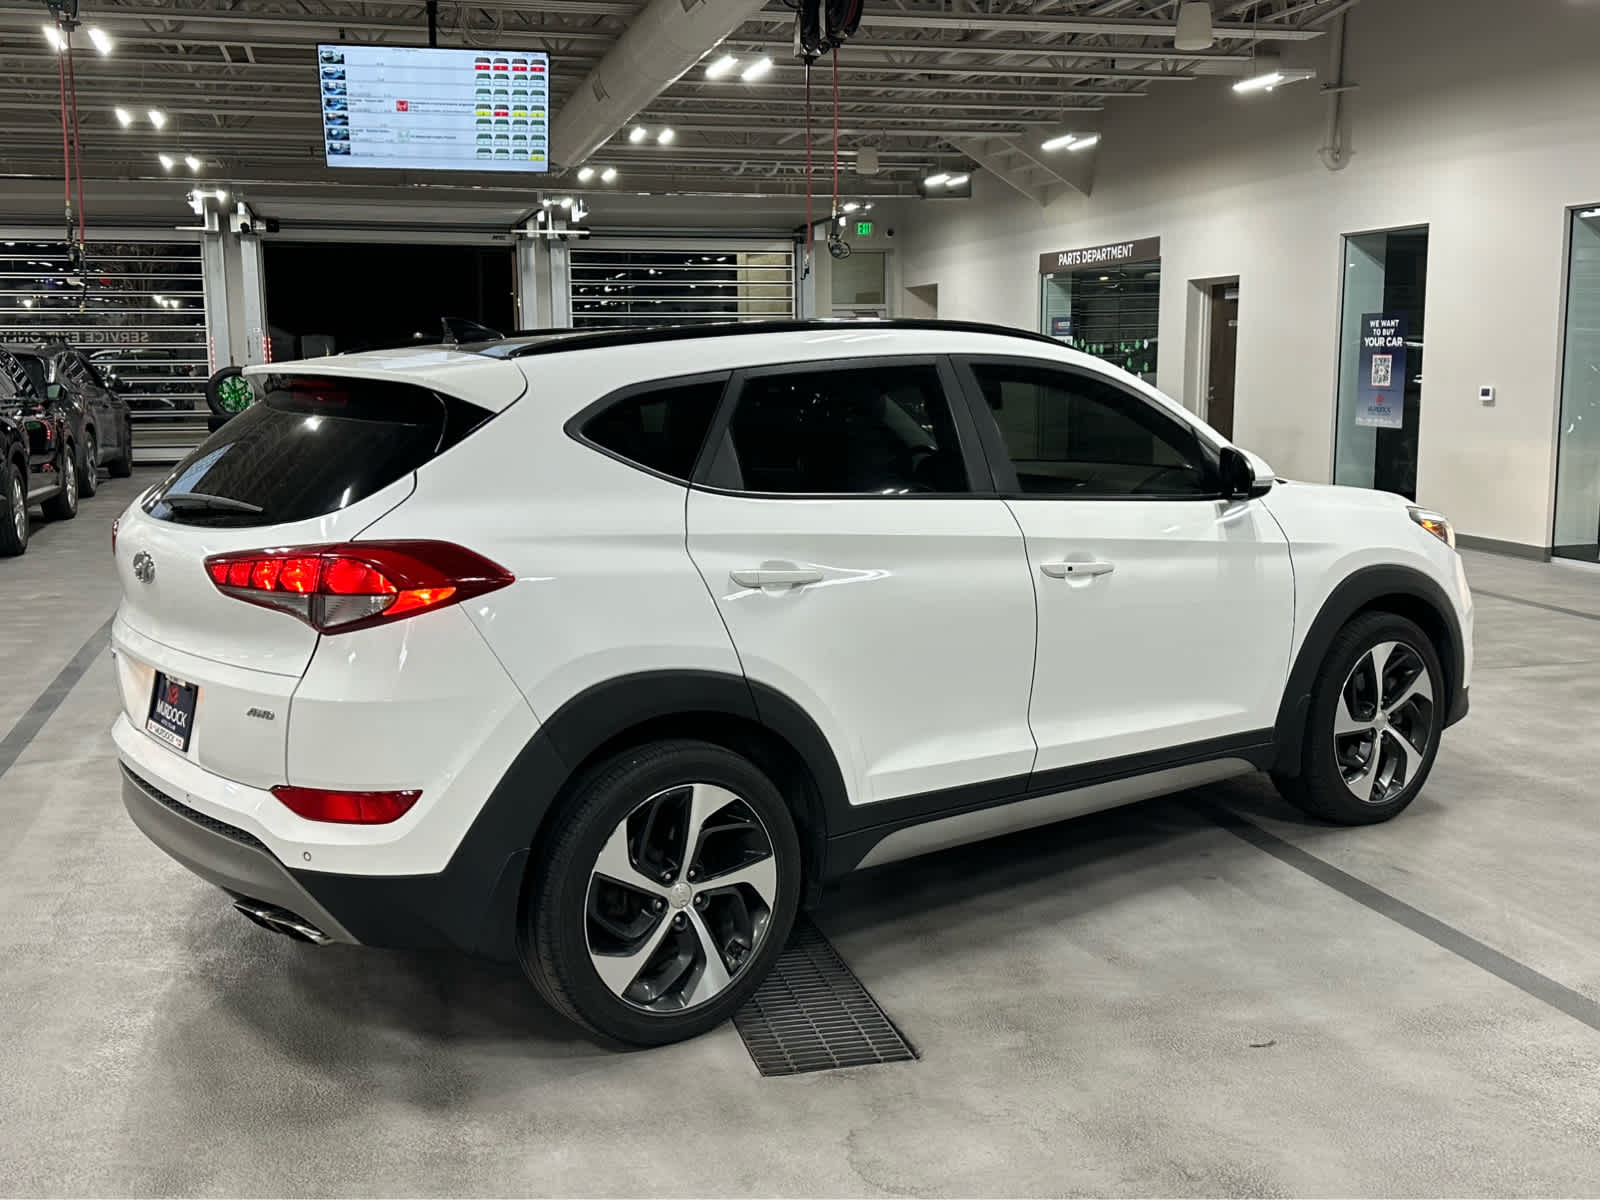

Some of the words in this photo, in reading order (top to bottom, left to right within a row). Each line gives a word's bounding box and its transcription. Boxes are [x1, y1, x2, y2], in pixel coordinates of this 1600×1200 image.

[857, 223, 871, 235] EXIT
[1058, 252, 1080, 266] PARTS
[1082, 244, 1134, 264] DEPARTMENT
[1370, 320, 1380, 328] WE
[1381, 319, 1400, 327] WANT
[1373, 328, 1382, 336] TO
[1382, 328, 1395, 336] BUY
[1364, 336, 1386, 347] YOUR
[1386, 336, 1404, 347] CAR
[156, 698, 187, 728] MURDOCK
[246, 707, 275, 721] AWD
